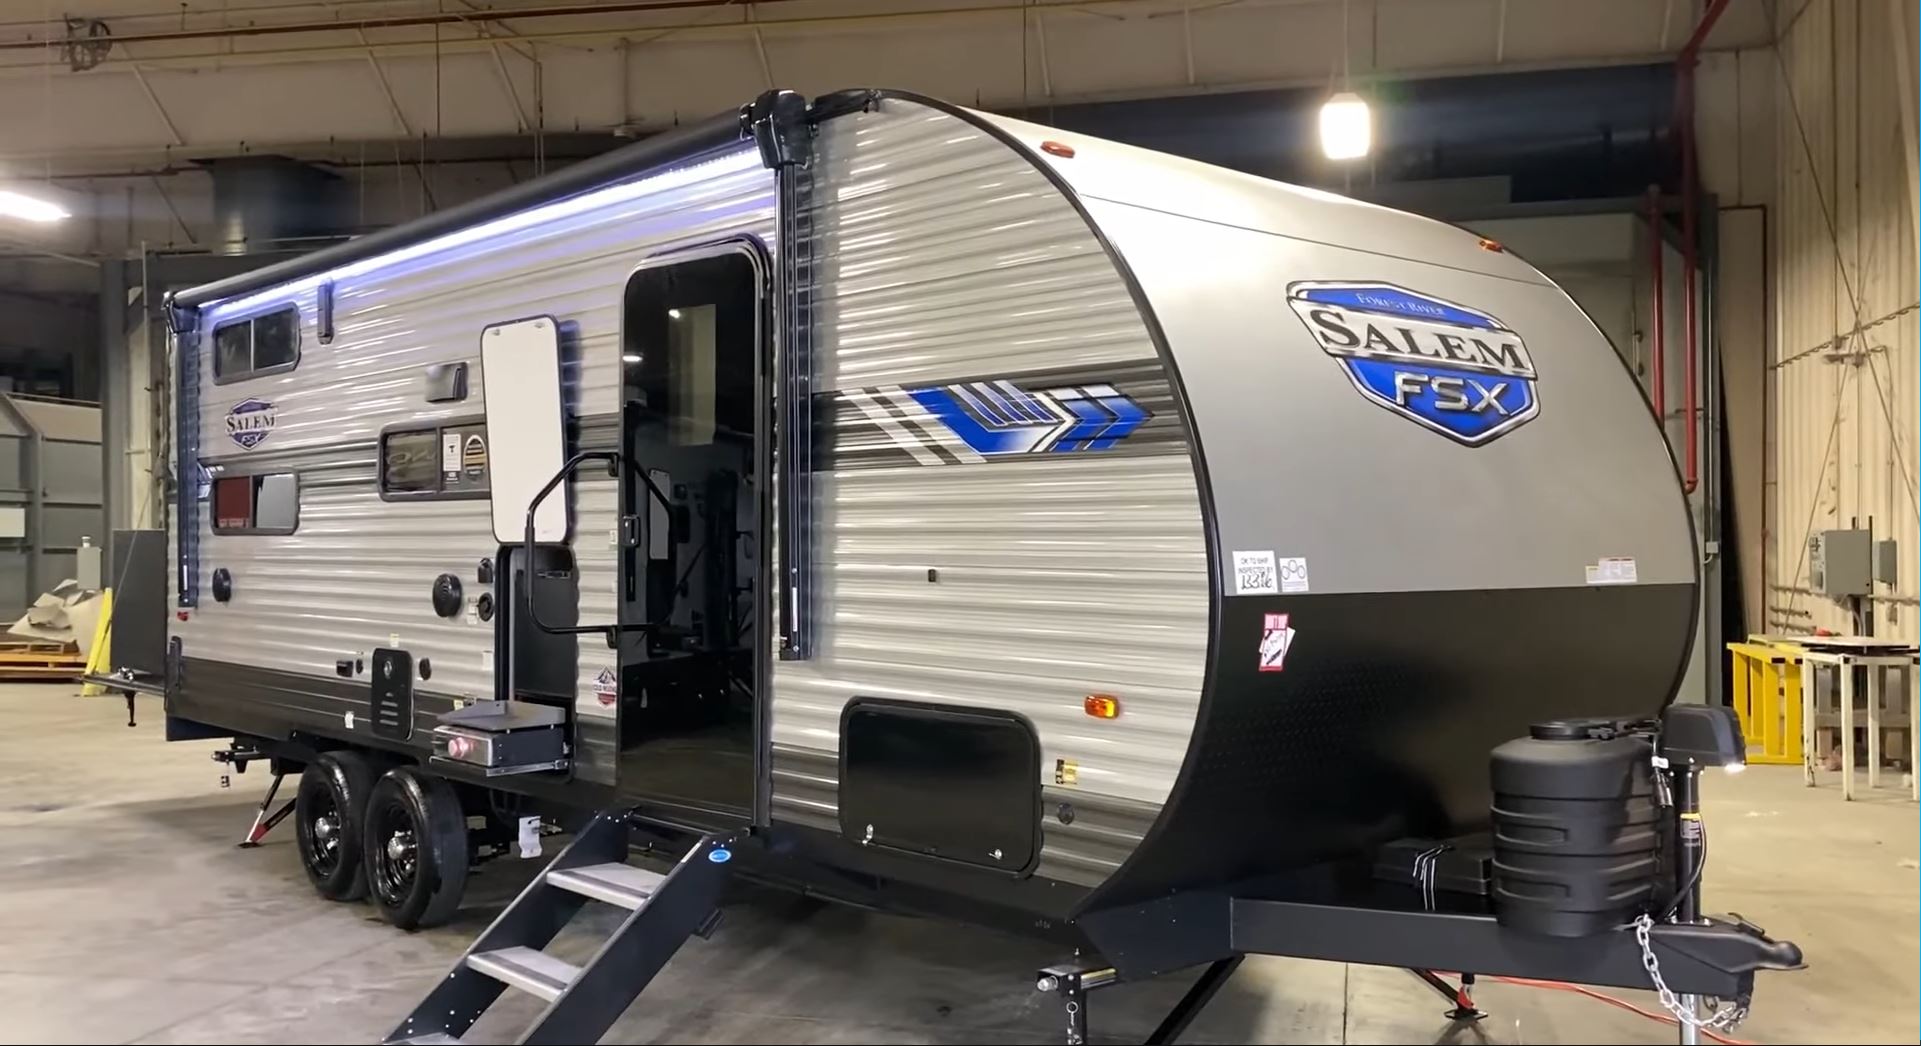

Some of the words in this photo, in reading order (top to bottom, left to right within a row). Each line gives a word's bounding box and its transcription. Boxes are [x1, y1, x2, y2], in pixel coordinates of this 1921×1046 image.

[1309, 309, 1534, 371] SALEM
[1394, 371, 1510, 415] FSX
[226, 414, 276, 433] SALEM
